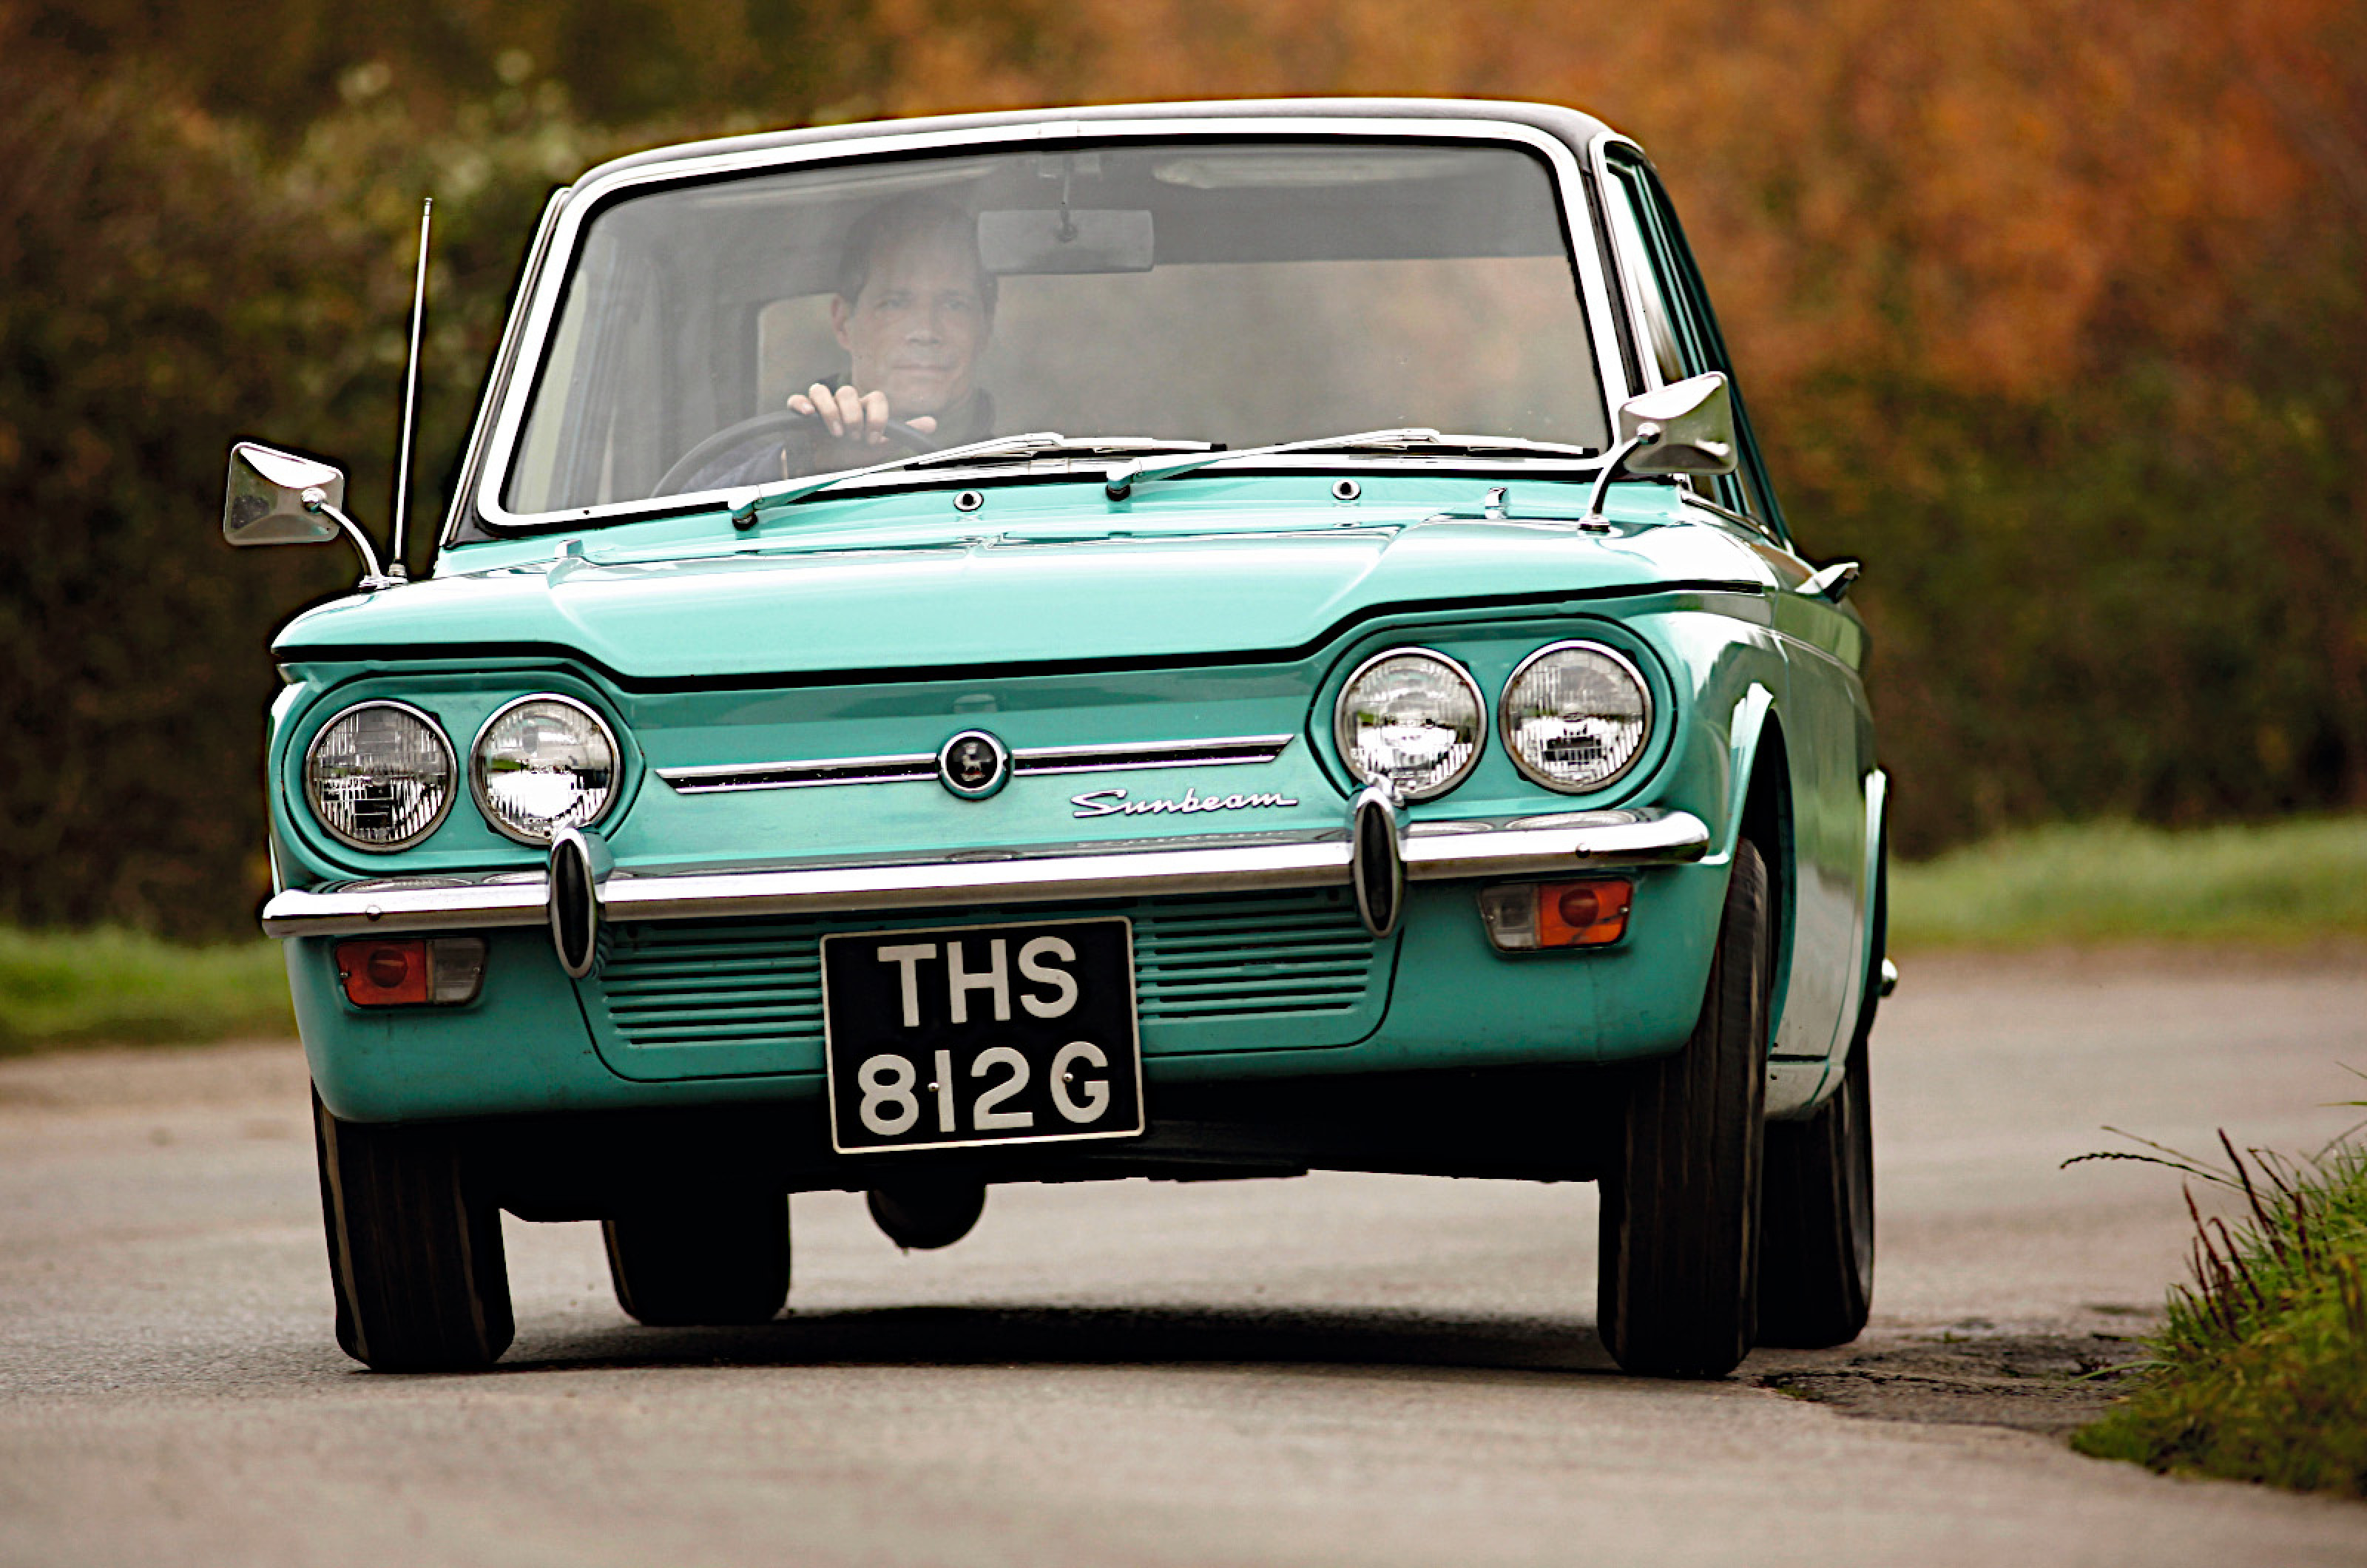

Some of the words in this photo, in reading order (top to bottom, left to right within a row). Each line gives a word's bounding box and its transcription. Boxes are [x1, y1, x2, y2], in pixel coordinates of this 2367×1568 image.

[1070, 788, 1298, 818] Sunbeam
[877, 936, 1078, 1027] THS
[857, 1041, 1110, 1135] 812G
